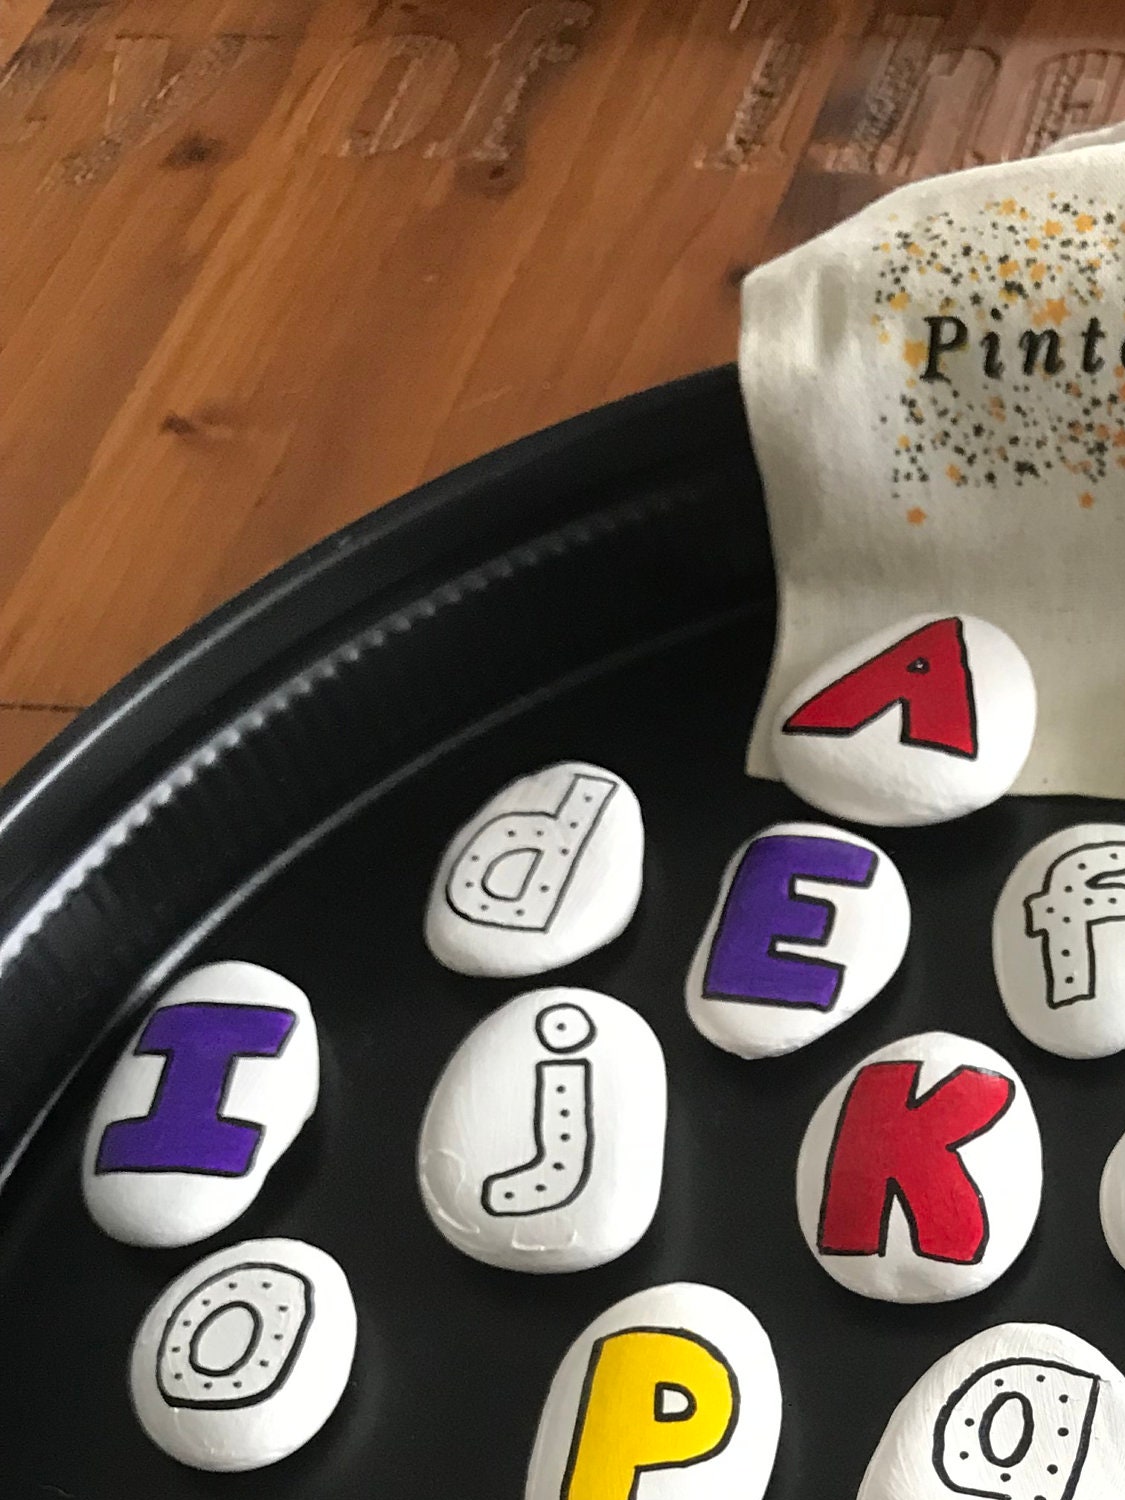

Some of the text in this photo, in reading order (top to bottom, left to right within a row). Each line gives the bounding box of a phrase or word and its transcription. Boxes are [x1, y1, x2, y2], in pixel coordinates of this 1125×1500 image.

[780, 615, 979, 759] A
[444, 772, 618, 934] d
[702, 833, 881, 1011] E
[93, 1001, 298, 1177] I
[480, 1001, 597, 1218] j
[815, 1058, 1015, 1266] K
